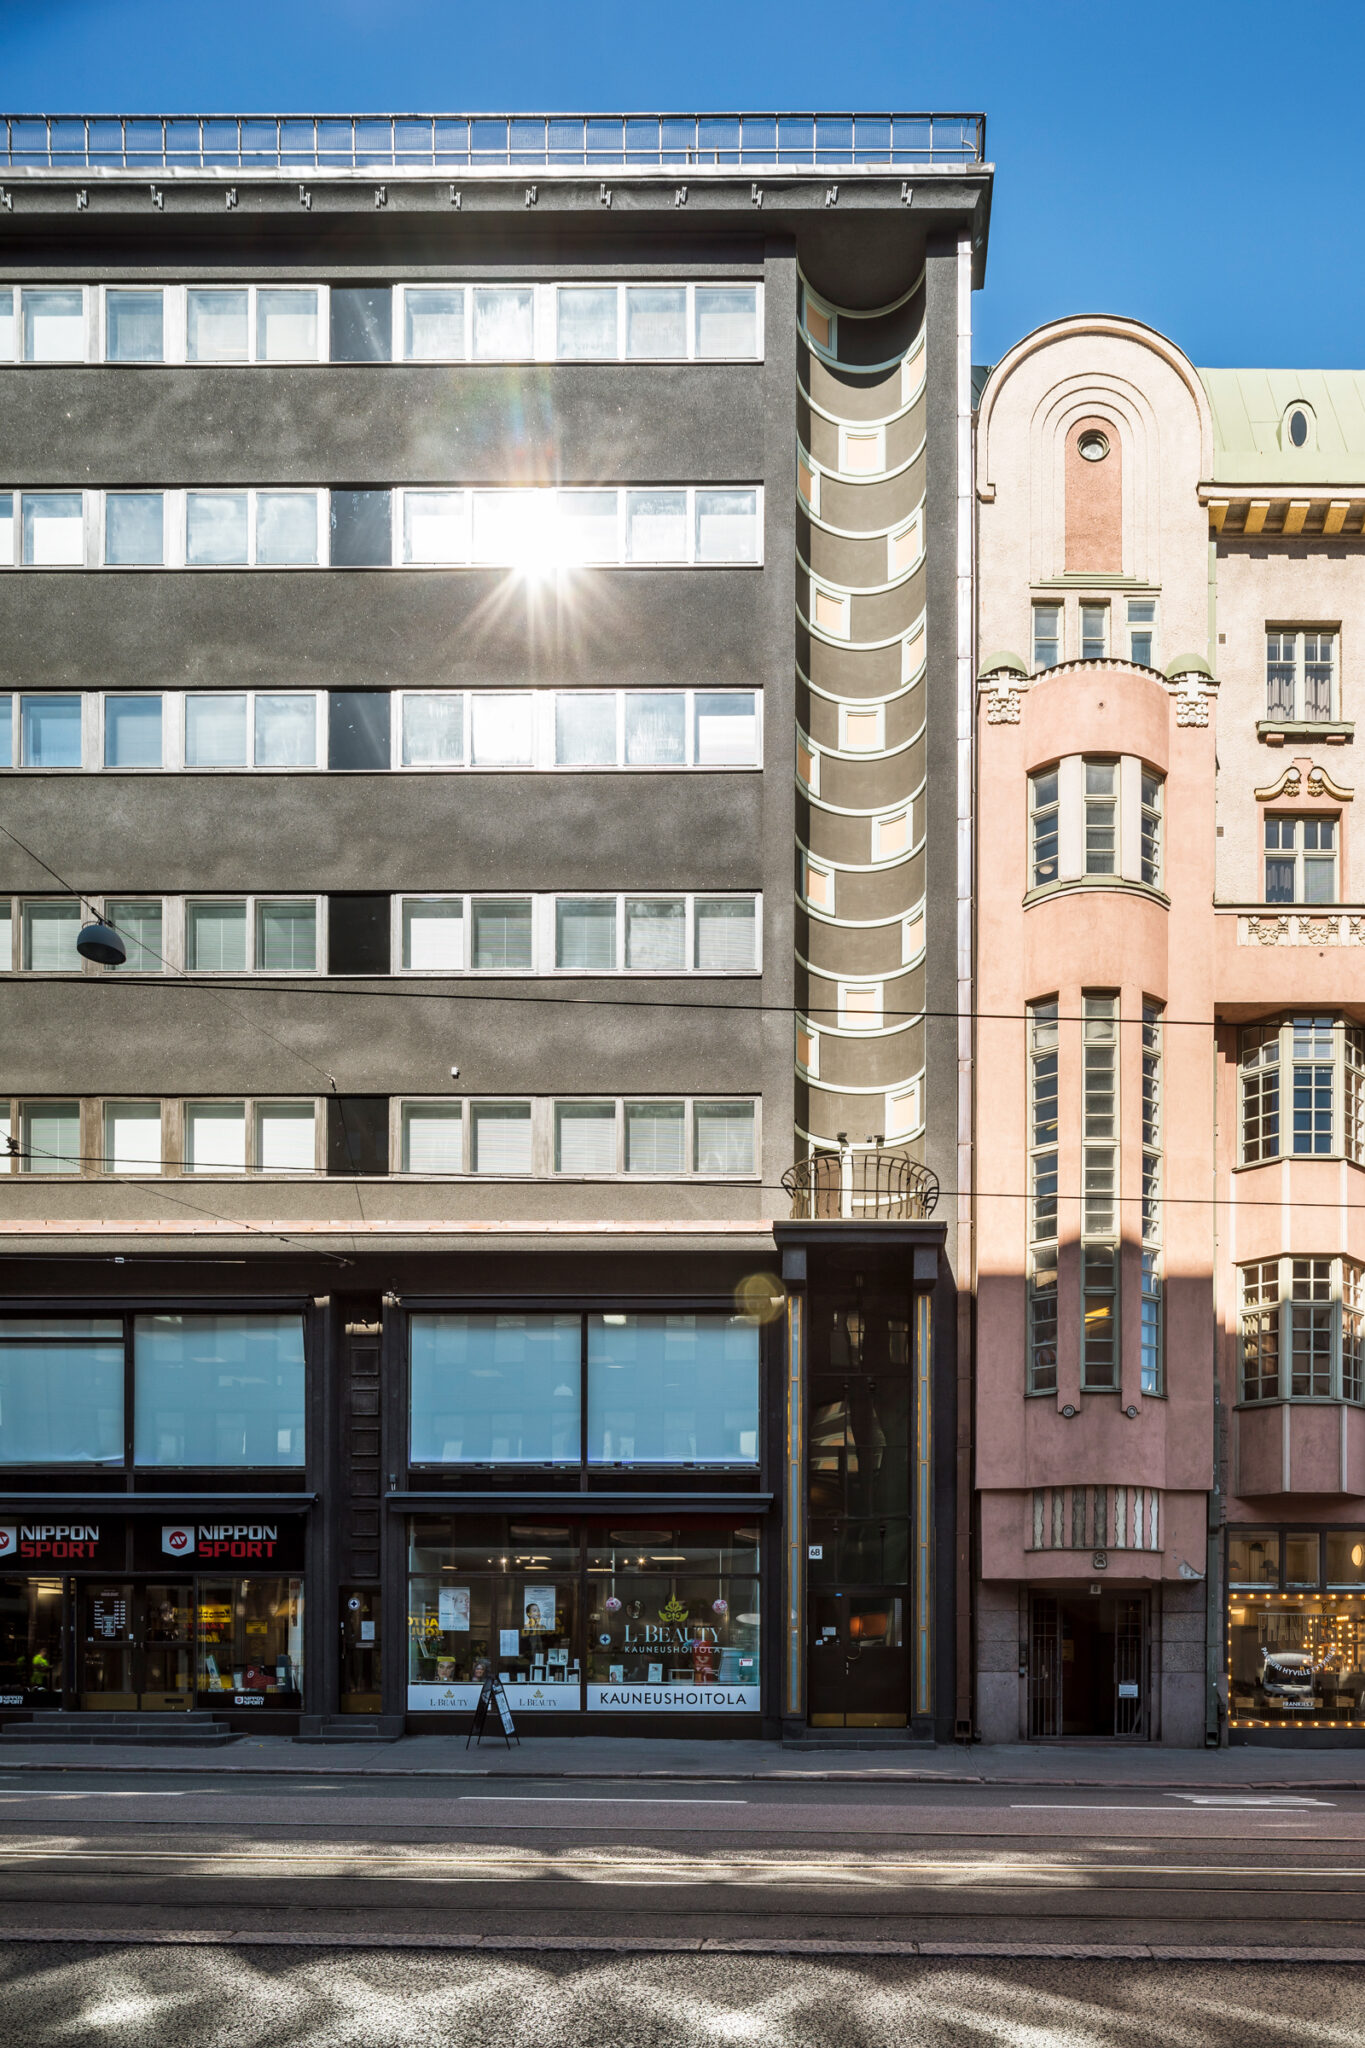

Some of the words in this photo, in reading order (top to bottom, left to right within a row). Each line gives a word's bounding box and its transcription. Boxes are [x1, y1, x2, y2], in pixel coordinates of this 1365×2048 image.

[21, 1526, 99, 1540] NIPPON
[199, 1526, 277, 1540] NIPPON
[21, 1542, 99, 1557] SPORT
[199, 1542, 277, 1557] SPORT
[1093, 1551, 1107, 1569] 8
[624, 1624, 722, 1643] L-BEAUTY
[624, 1646, 721, 1654] KAUNEUSHOITOLA
[1282, 1667, 1311, 1676] HYVILLE
[600, 1693, 747, 1704] KAUNEUSHOITOLA
